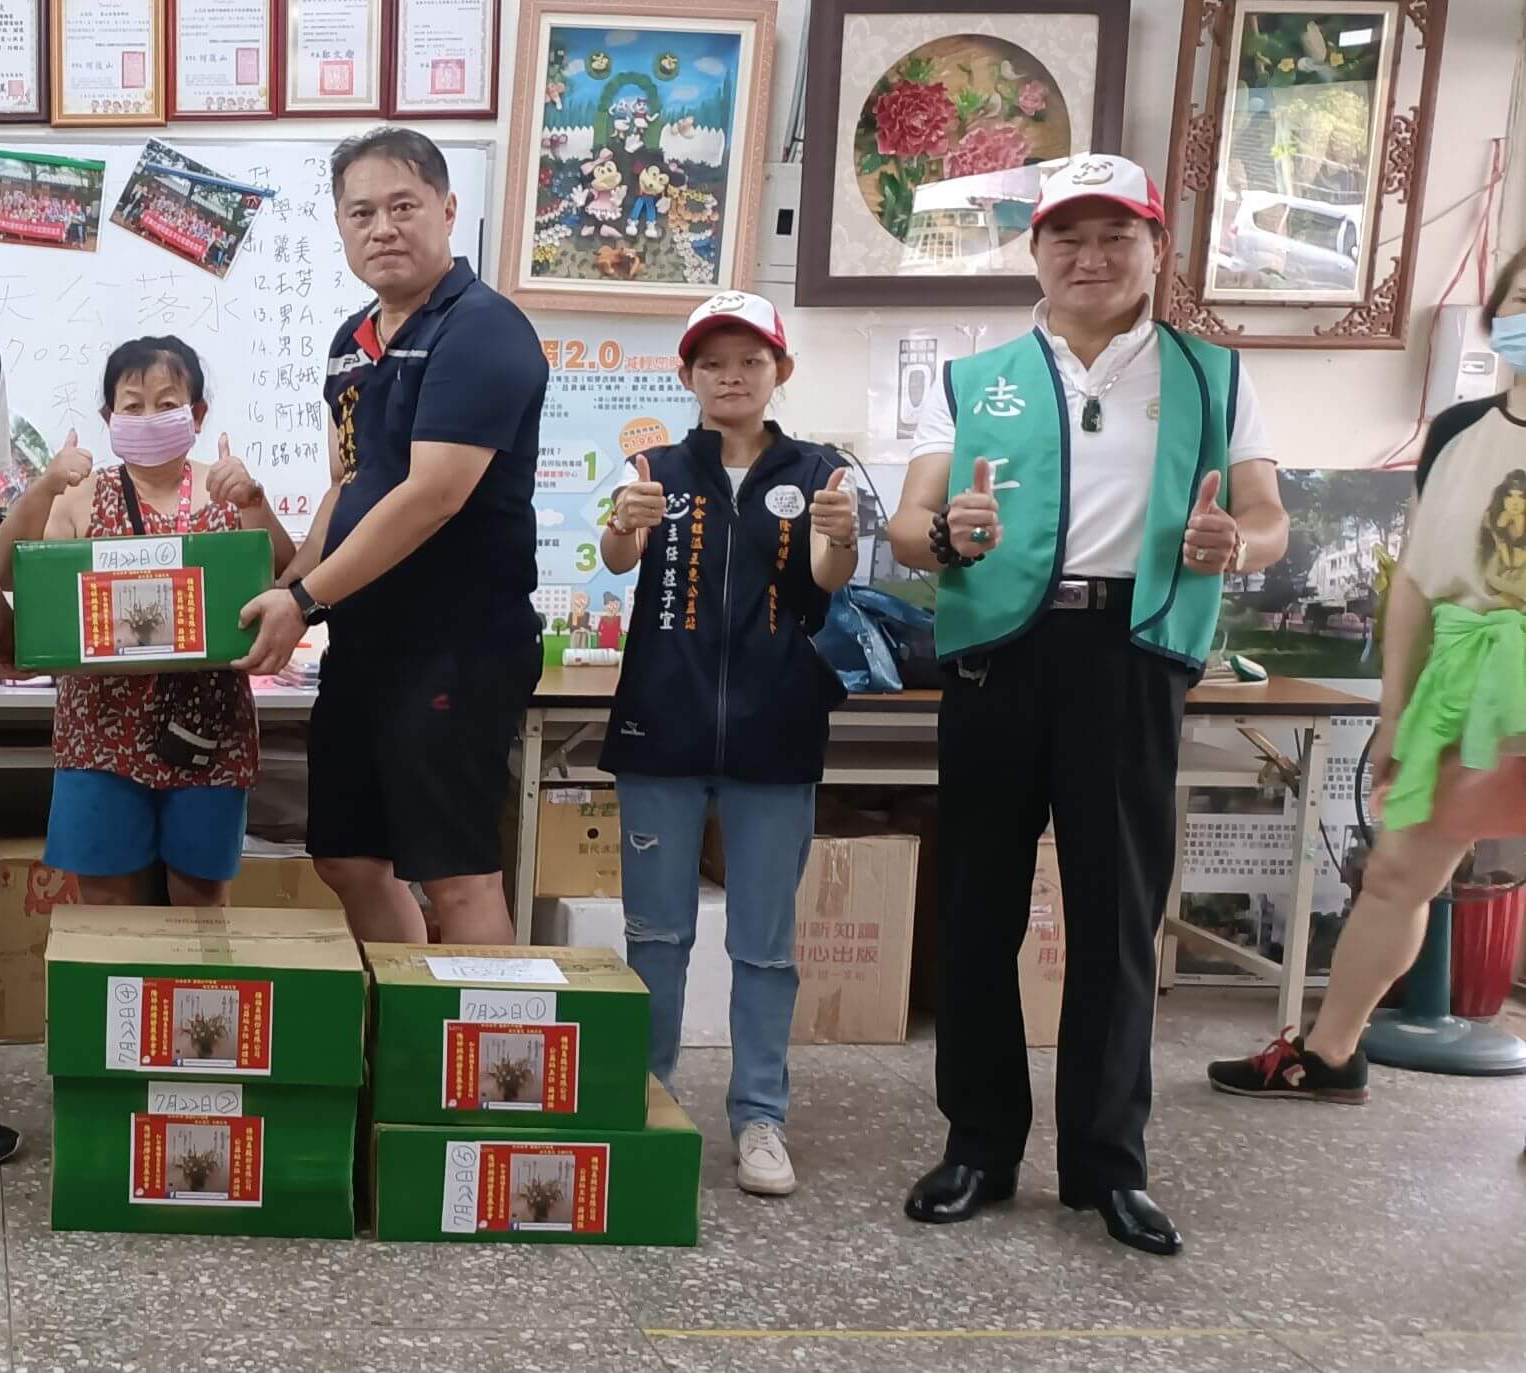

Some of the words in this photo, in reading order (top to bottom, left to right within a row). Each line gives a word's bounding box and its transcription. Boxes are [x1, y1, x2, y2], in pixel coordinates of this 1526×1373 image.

[584, 452, 596, 481] 1
[666, 523, 679, 561] 主任
[576, 543, 597, 572] 3
[799, 922, 879, 939] 新知識
